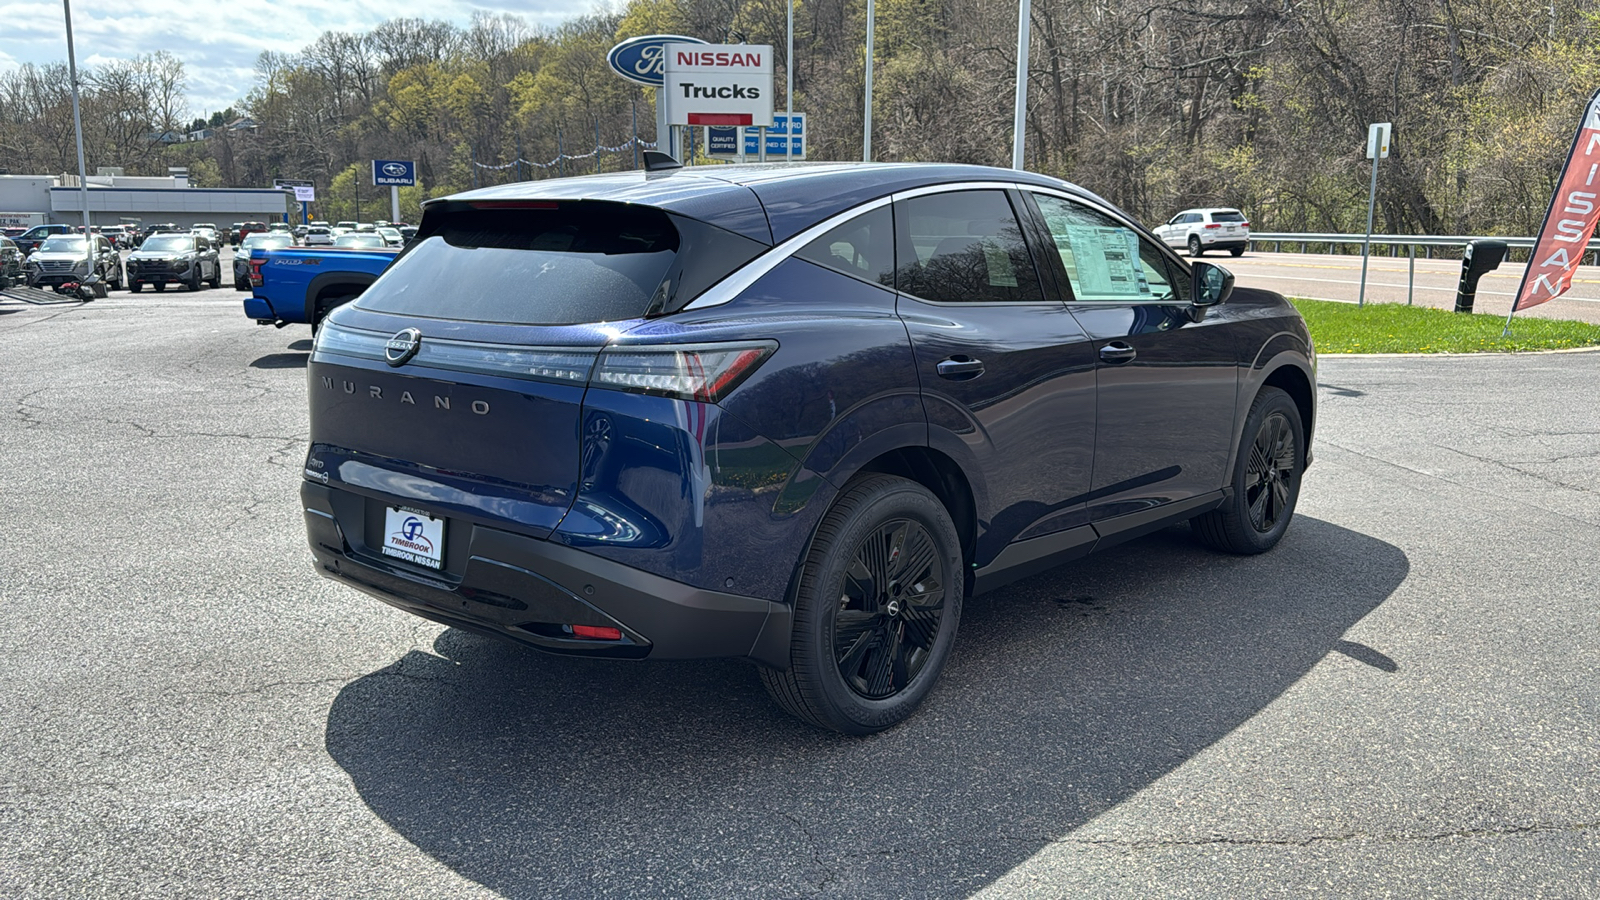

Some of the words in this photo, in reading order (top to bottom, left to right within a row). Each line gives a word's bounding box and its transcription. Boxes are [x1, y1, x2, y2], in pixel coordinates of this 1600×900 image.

[677, 52, 761, 67] NISSAN
[679, 83, 760, 99] Trucks
[781, 121, 802, 129] FRD
[322, 376, 490, 416] MURANO
[391, 536, 430, 553] TIMBROOK
[381, 545, 415, 562] TIMBROOK
[414, 555, 441, 570] NISSAN
